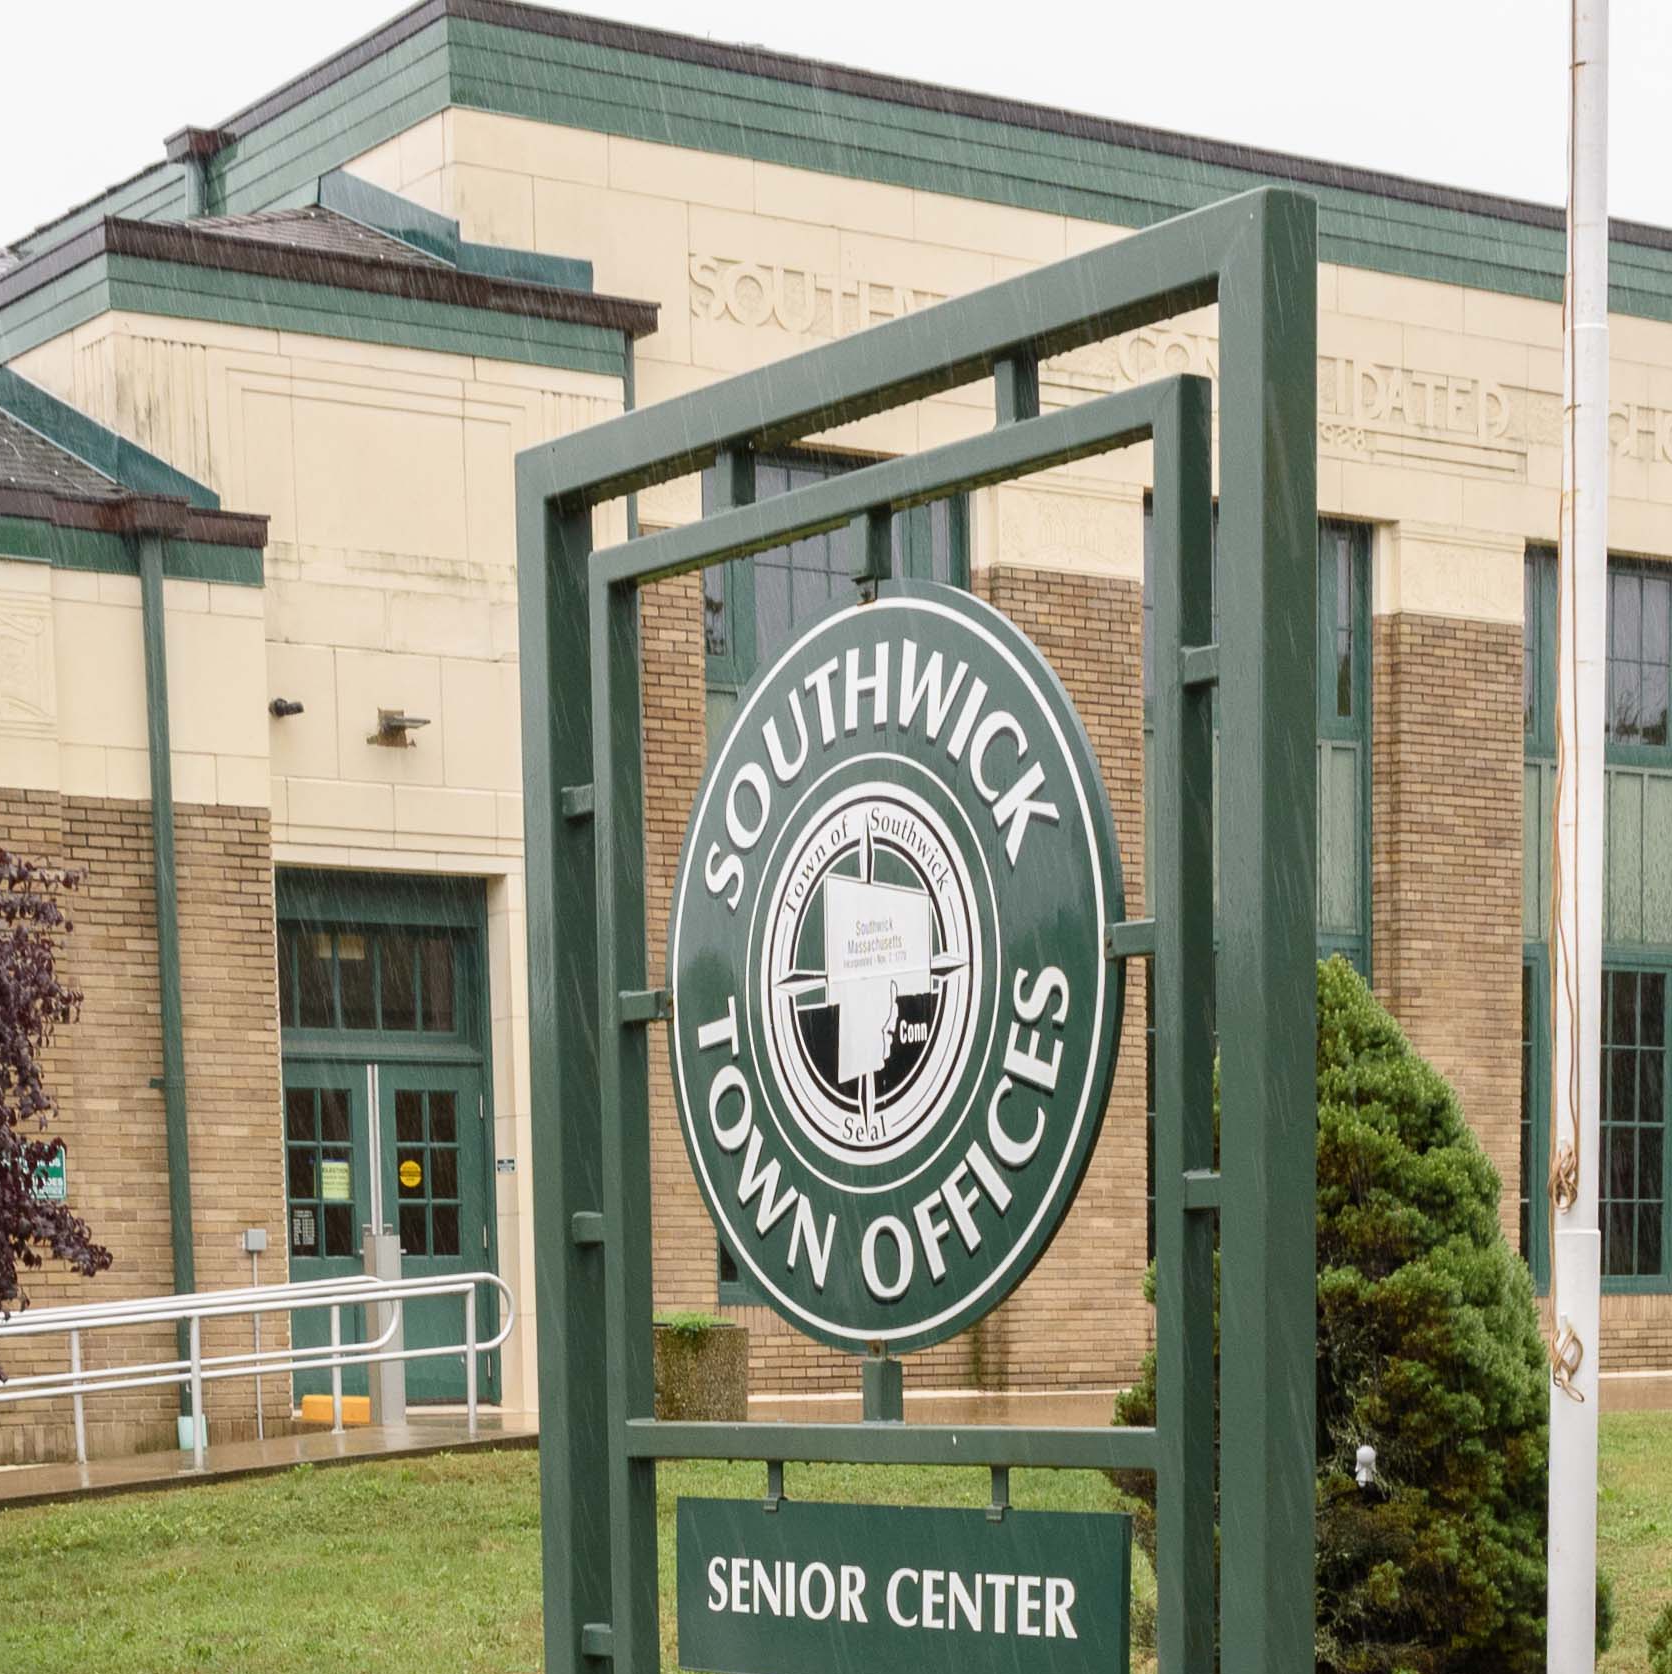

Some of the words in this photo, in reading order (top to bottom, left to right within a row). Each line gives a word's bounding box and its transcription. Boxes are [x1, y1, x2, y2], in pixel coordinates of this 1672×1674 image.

[704, 637, 1060, 911] SOUTHWICK
[783, 843, 828, 915] Town
[830, 814, 850, 846] of
[869, 807, 950, 893] Southwick
[696, 996, 838, 1291] TOWN
[861, 963, 1071, 1300] OFFICES
[842, 1116, 888, 1143] Seal
[707, 1555, 869, 1624] SENIOR
[885, 1566, 1079, 1639] CENTER
